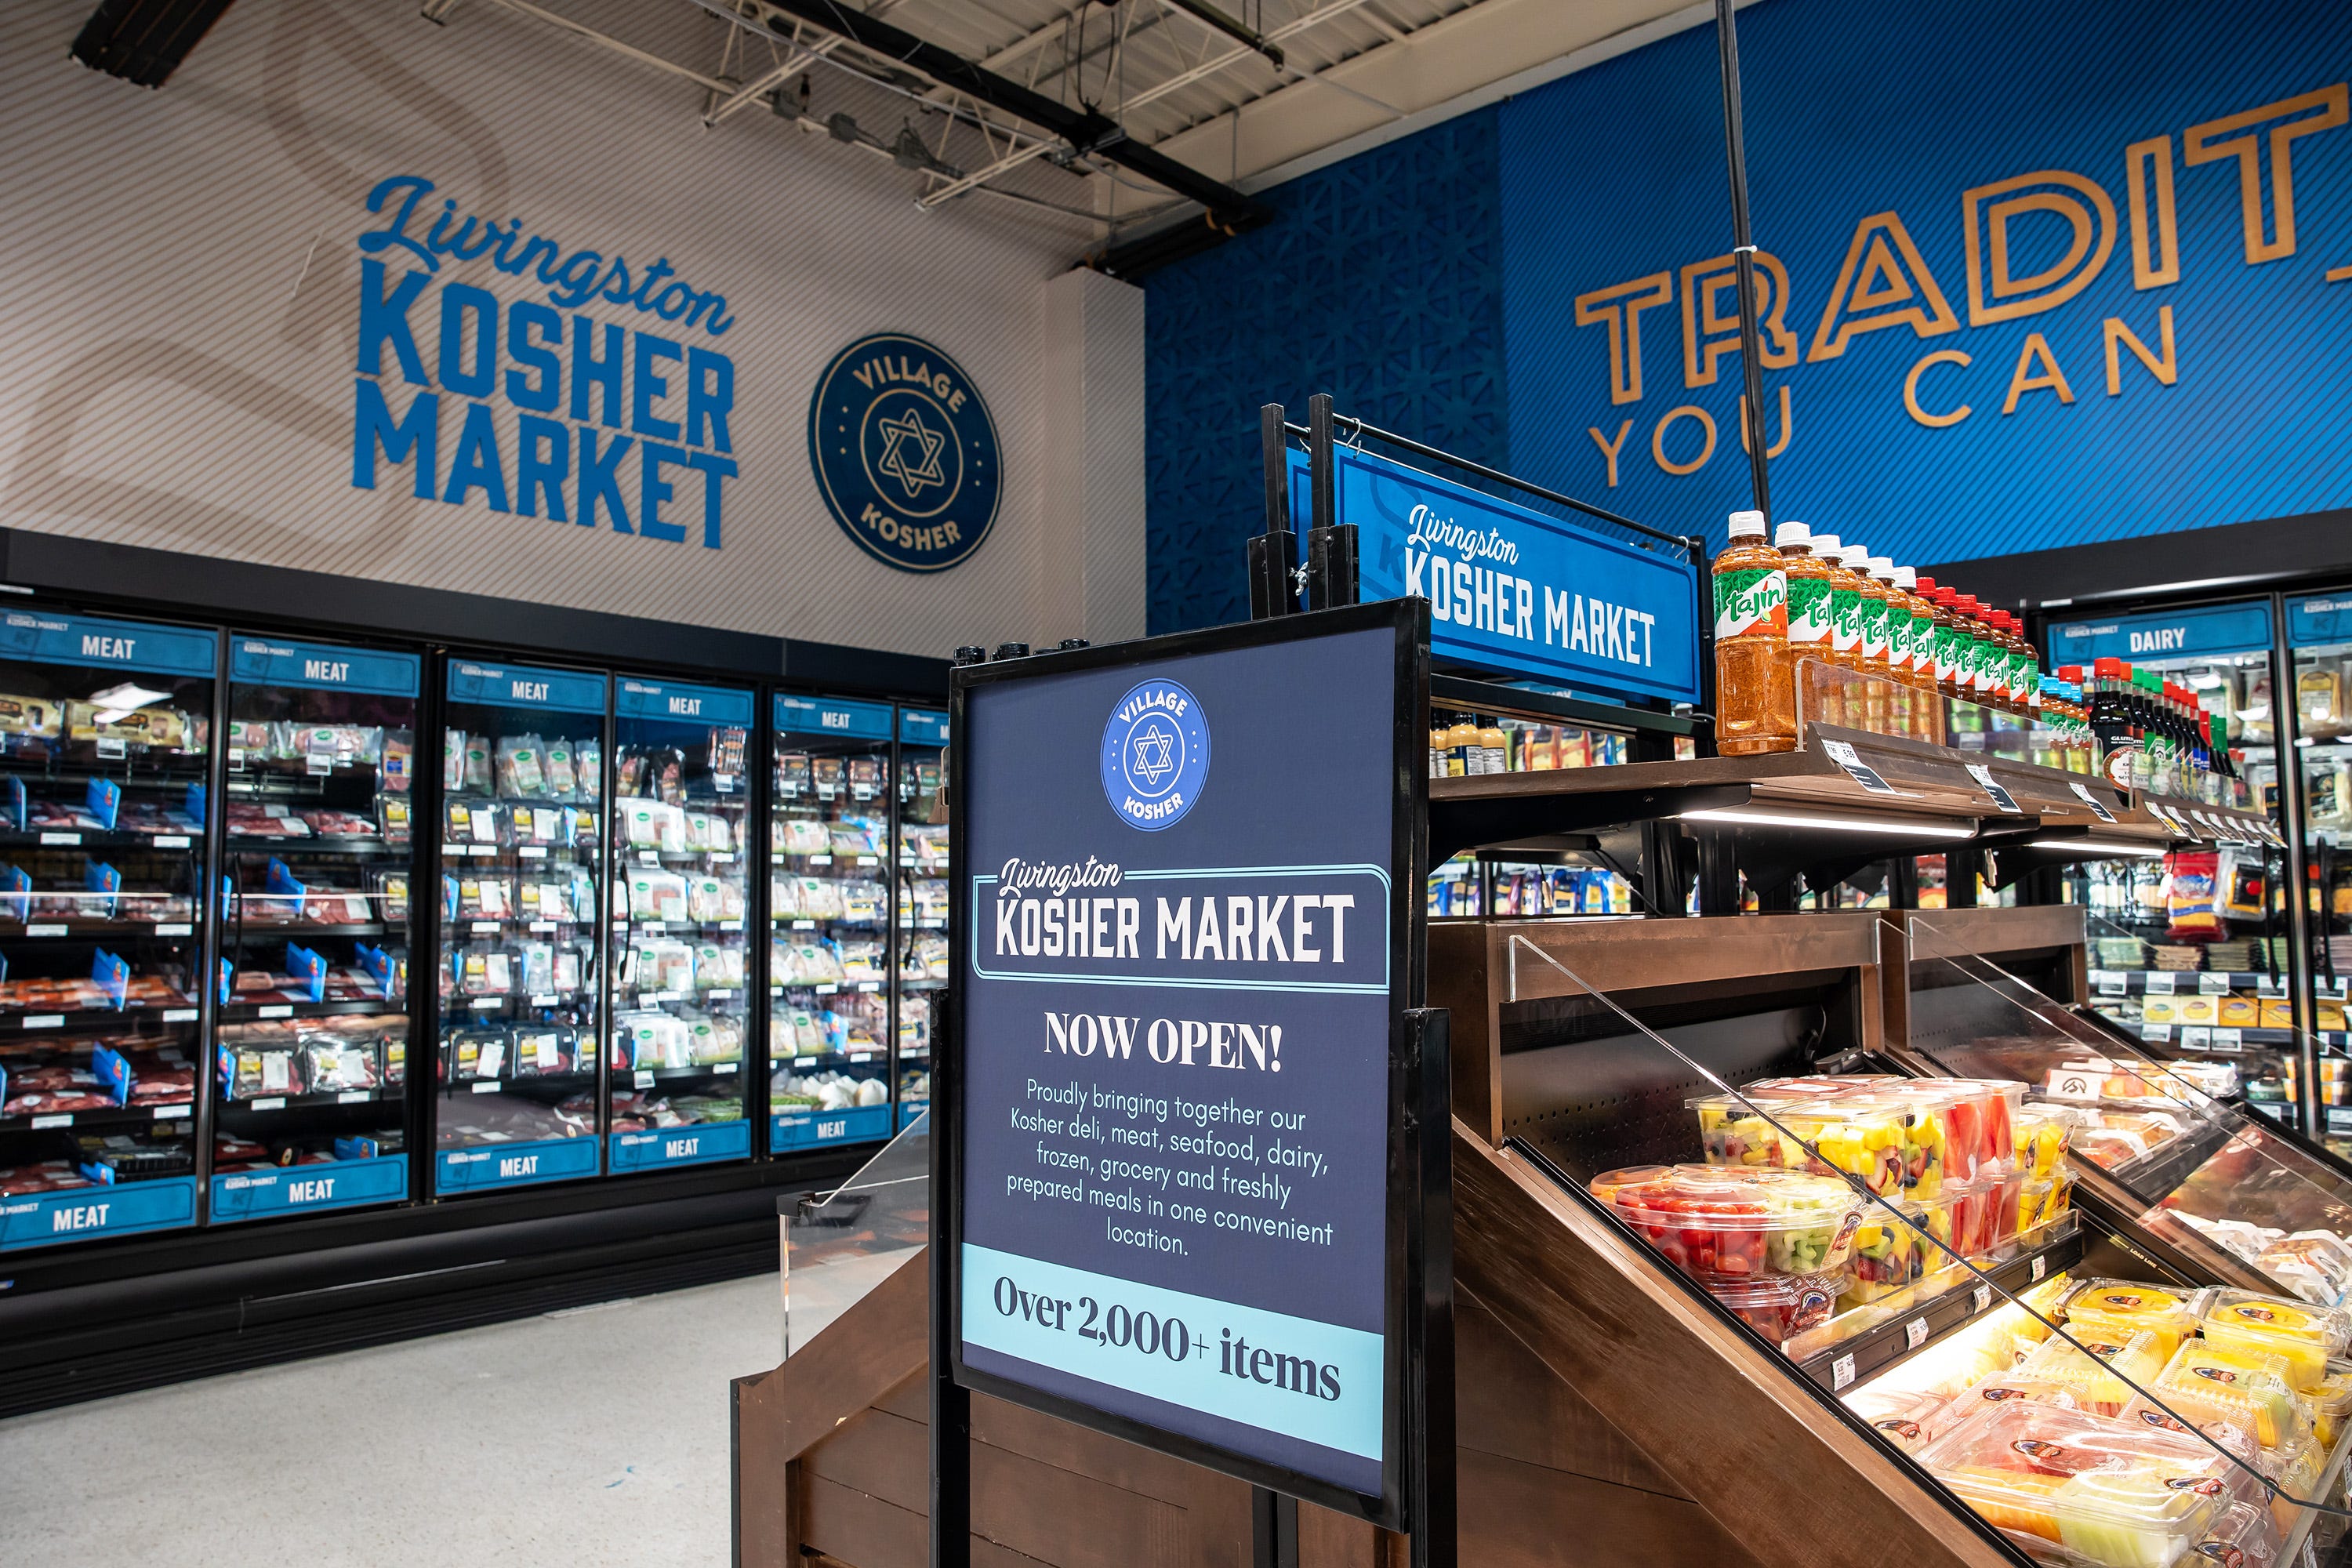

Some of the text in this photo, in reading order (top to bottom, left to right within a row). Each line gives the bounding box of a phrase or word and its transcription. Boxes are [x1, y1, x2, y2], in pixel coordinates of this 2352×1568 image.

[358, 176, 735, 336] Livingston
[1575, 82, 2349, 406] TRADIT
[358, 257, 734, 454] KOSHER
[852, 355, 965, 413] VILLAGE
[1588, 306, 2177, 487] YOU CAN
[351, 377, 738, 550] MARKET
[860, 502, 962, 551] KOSHER
[1407, 504, 1519, 565] Livingston
[1405, 547, 1655, 667] KOSHER MARKET
[82, 635, 136, 659] MEAT
[2130, 627, 2185, 652] DAIRY
[305, 659, 349, 682] MEAT
[512, 681, 549, 701] MEAT
[669, 696, 702, 715] MEAT
[822, 711, 851, 728] MEAT
[1118, 689, 1188, 724] VILLAGE
[1122, 792, 1184, 820] KOSHER
[999, 855, 1123, 898] Livingston
[996, 895, 1356, 963] KOSHER MARKET
[1044, 1011, 1283, 1073] NOW OPEN!
[1027, 1078, 1305, 1131] Proudly bringing together our
[666, 1138, 699, 1158] MEAT
[818, 1120, 846, 1139] MEAT
[1011, 1108, 1328, 1178] Kosher deli, meat, seafood, dairy,
[500, 1156, 539, 1178] MEAT
[1036, 1142, 1291, 1209] frozen, grocery and freshly
[289, 1178, 335, 1203] MEAT
[1007, 1174, 1334, 1246] prepared meals in one convenient
[53, 1204, 110, 1232] MEAT
[1107, 1217, 1189, 1256] location.
[2129, 1248, 2158, 1269] LOAD LINE
[994, 1276, 1341, 1401] Over 2,000+ items
